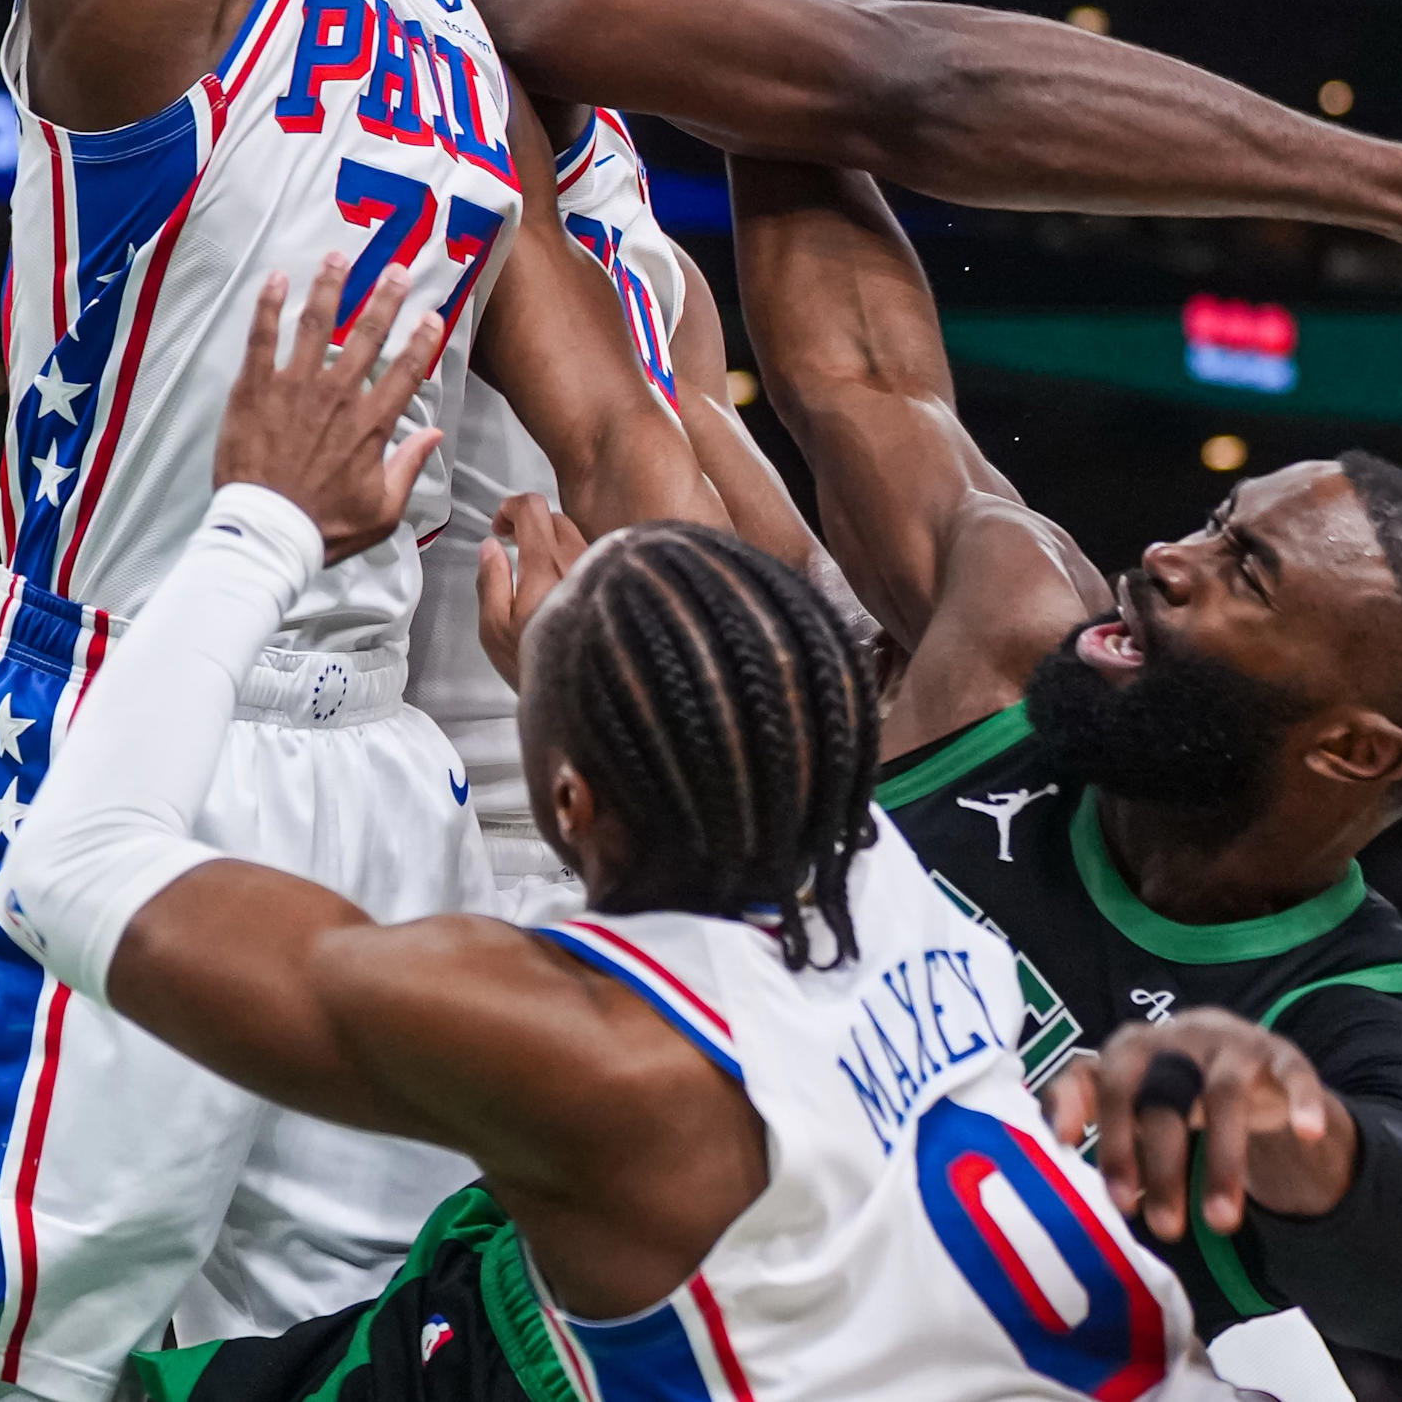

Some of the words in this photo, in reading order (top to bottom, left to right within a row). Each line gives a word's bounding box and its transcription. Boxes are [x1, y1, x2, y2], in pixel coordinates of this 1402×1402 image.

[332, 156, 505, 380] 77
[837, 949, 1005, 1157] MAXEY
[916, 1095, 1166, 1402] 0
